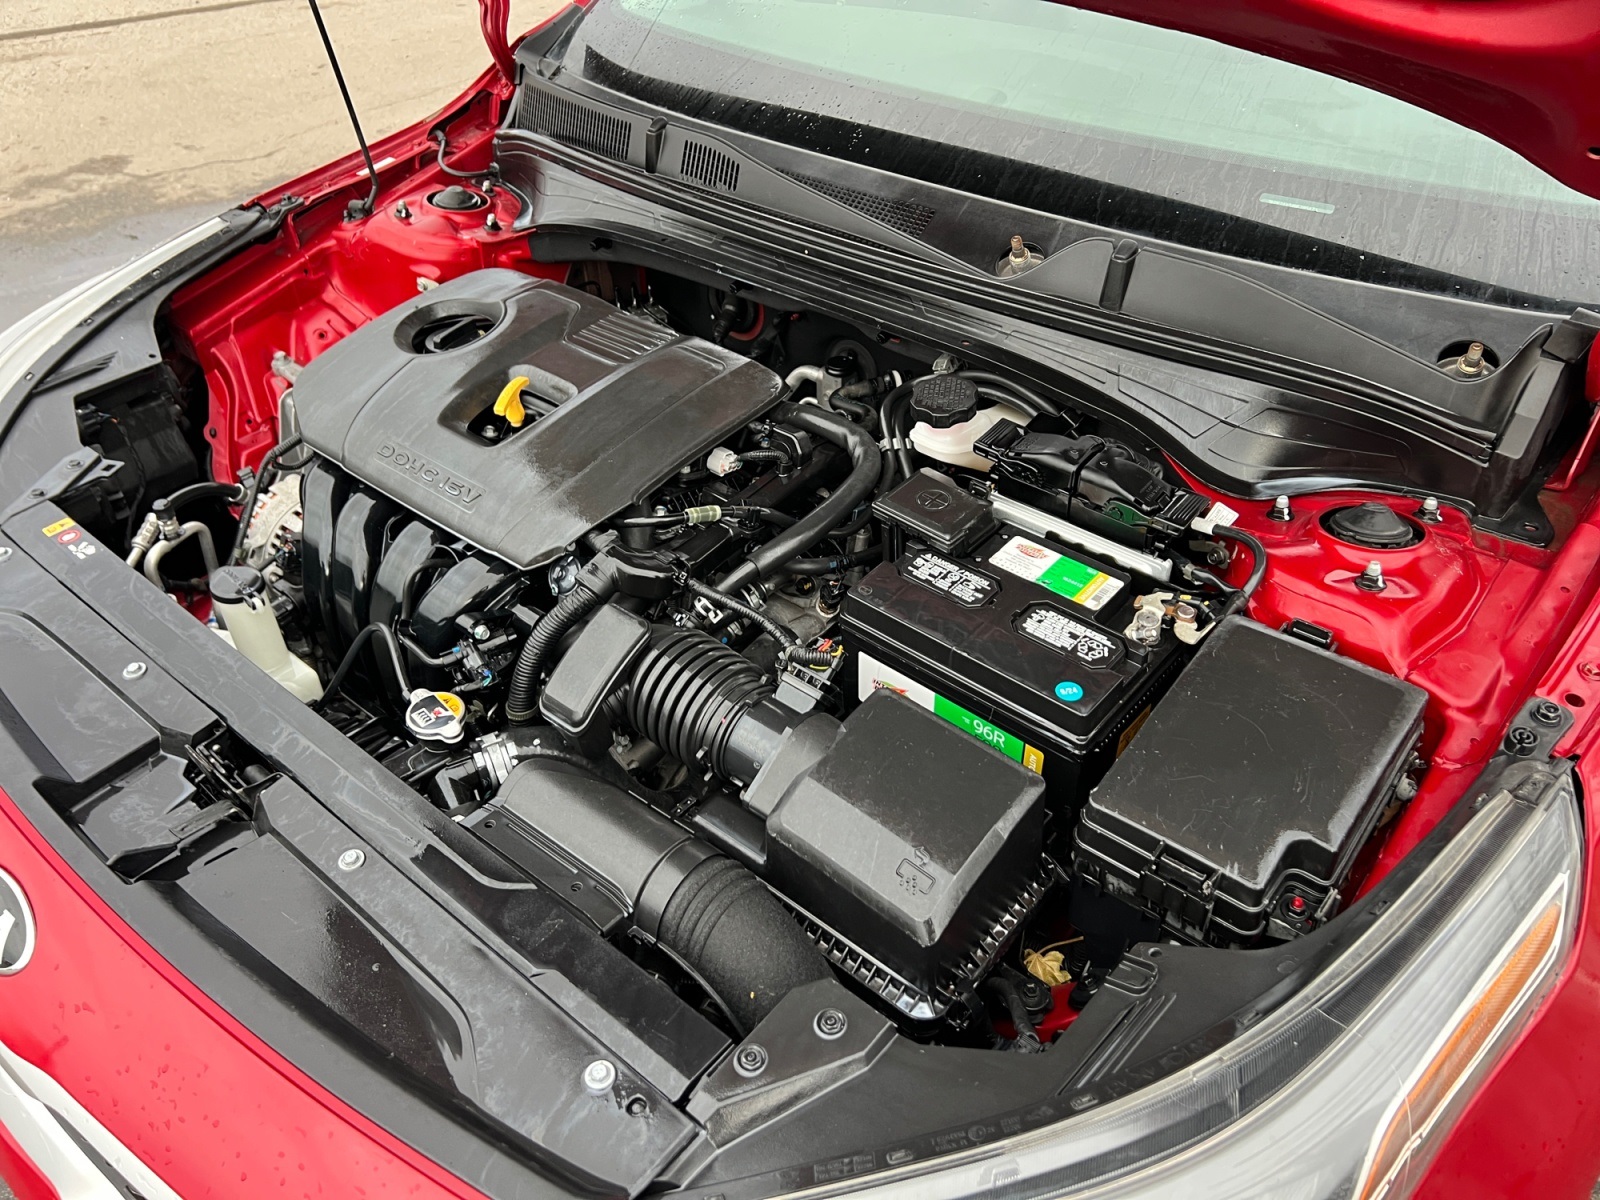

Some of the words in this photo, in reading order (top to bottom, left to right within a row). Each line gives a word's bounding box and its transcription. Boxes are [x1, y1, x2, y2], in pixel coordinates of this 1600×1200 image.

[376, 443, 440, 483] DOHC
[931, 555, 960, 573] DANGER
[963, 570, 990, 586] POISON
[973, 719, 1006, 749] 96R
